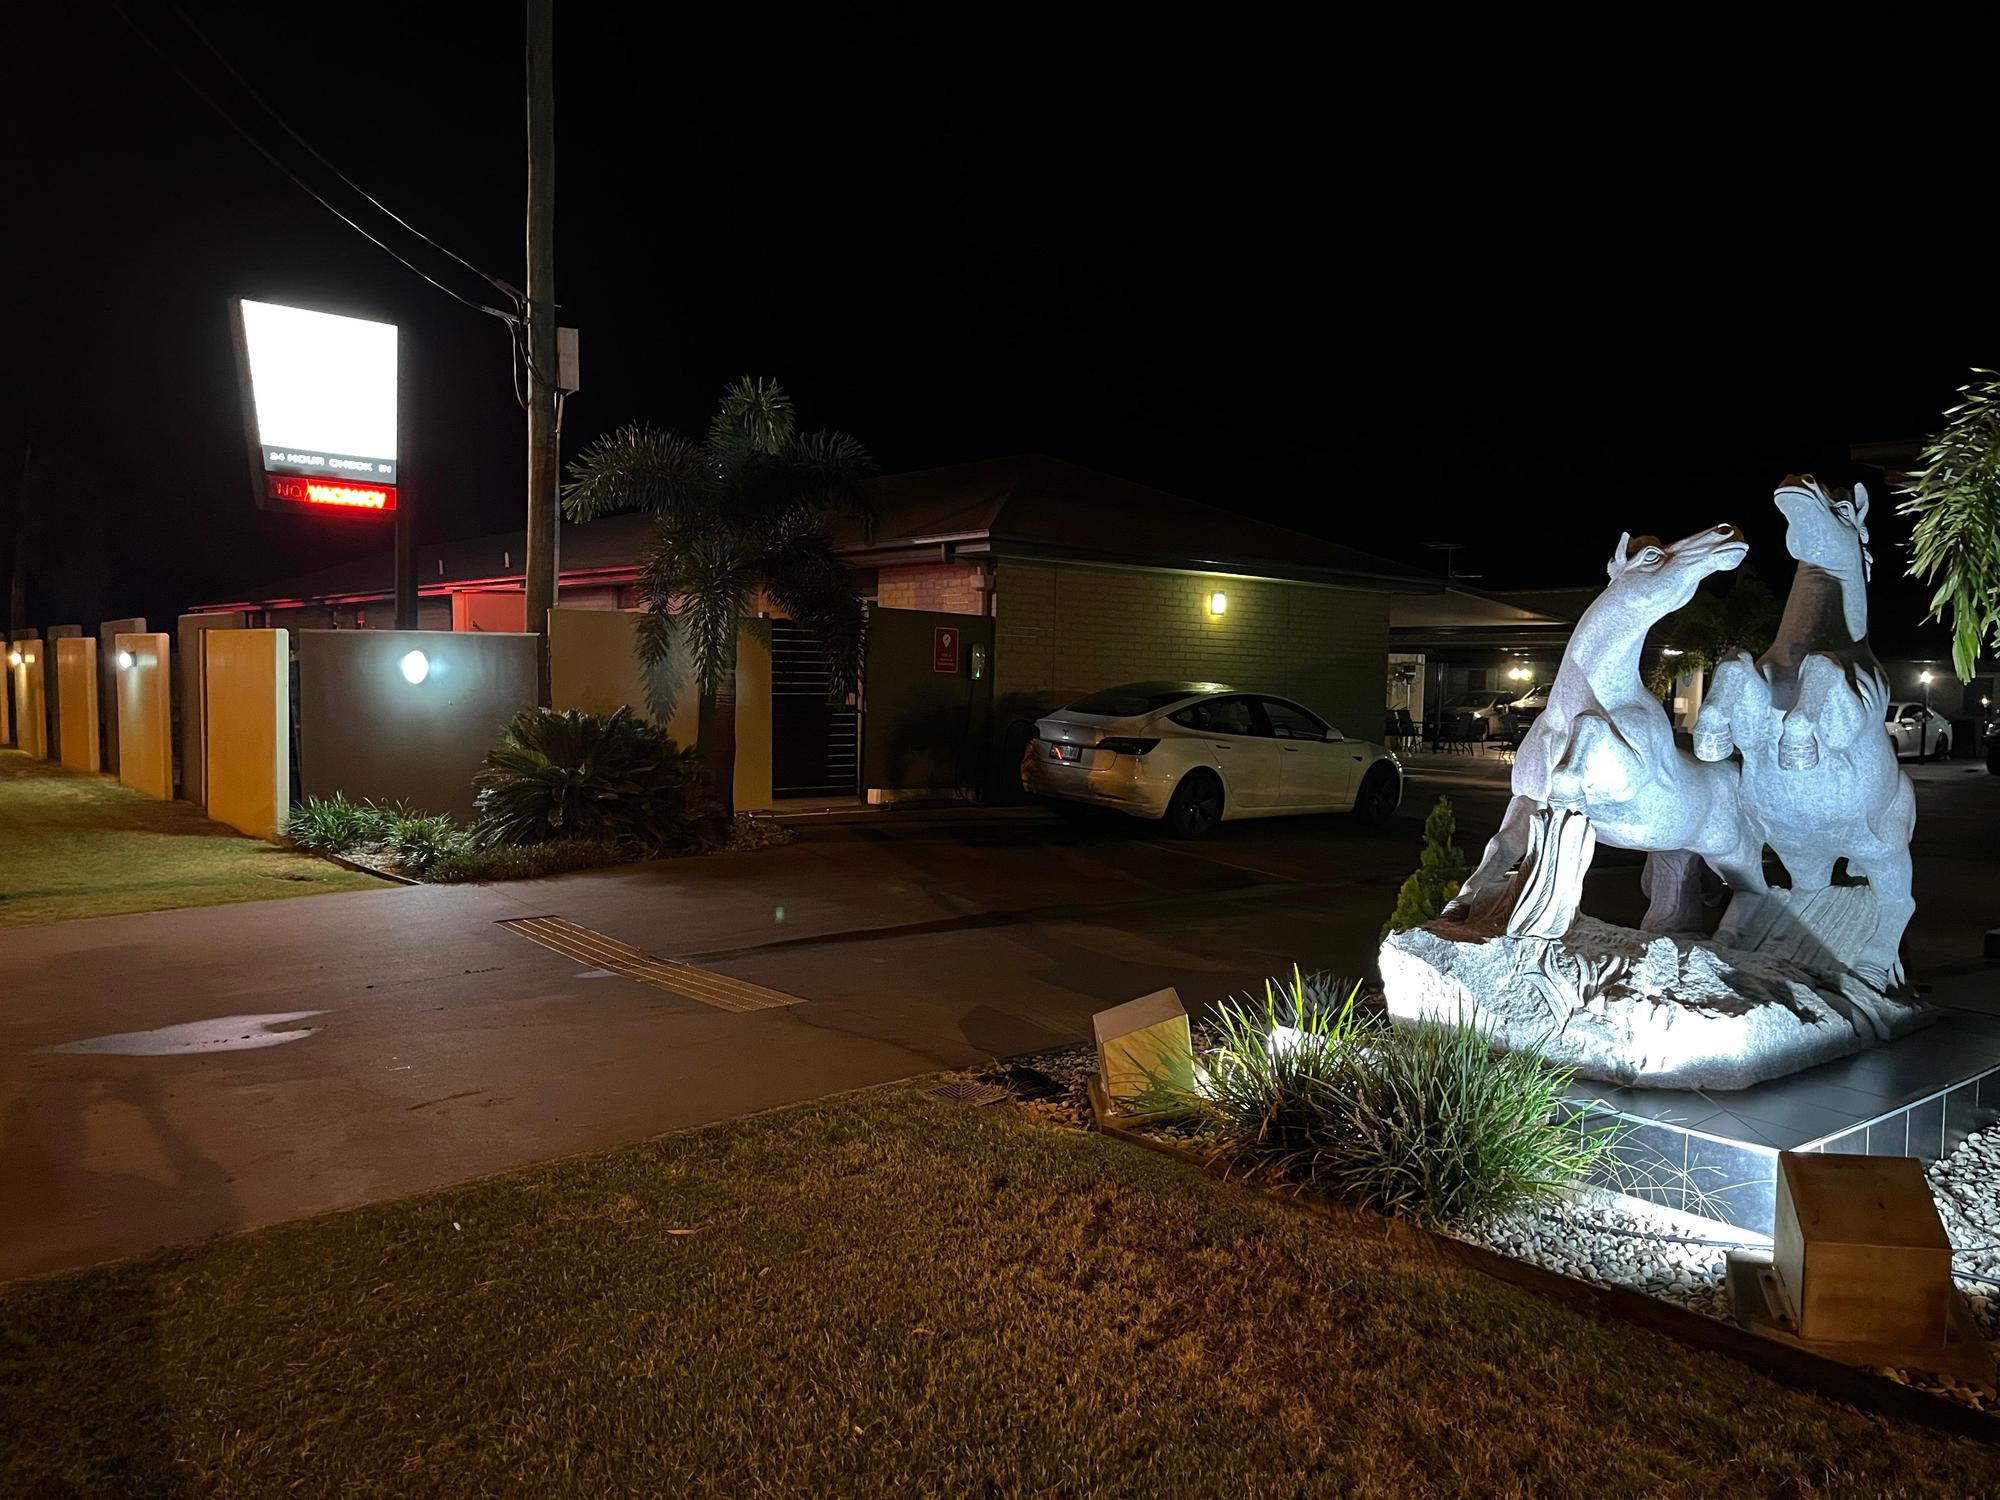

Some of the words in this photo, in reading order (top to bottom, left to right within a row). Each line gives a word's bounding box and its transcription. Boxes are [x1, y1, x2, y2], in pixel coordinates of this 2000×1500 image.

[270, 452, 285, 461] 24
[287, 453, 325, 466] HOUR
[329, 458, 373, 472] CHECK
[378, 463, 392, 474] IN
[277, 483, 303, 498] NO
[310, 485, 386, 509] VACANCY
